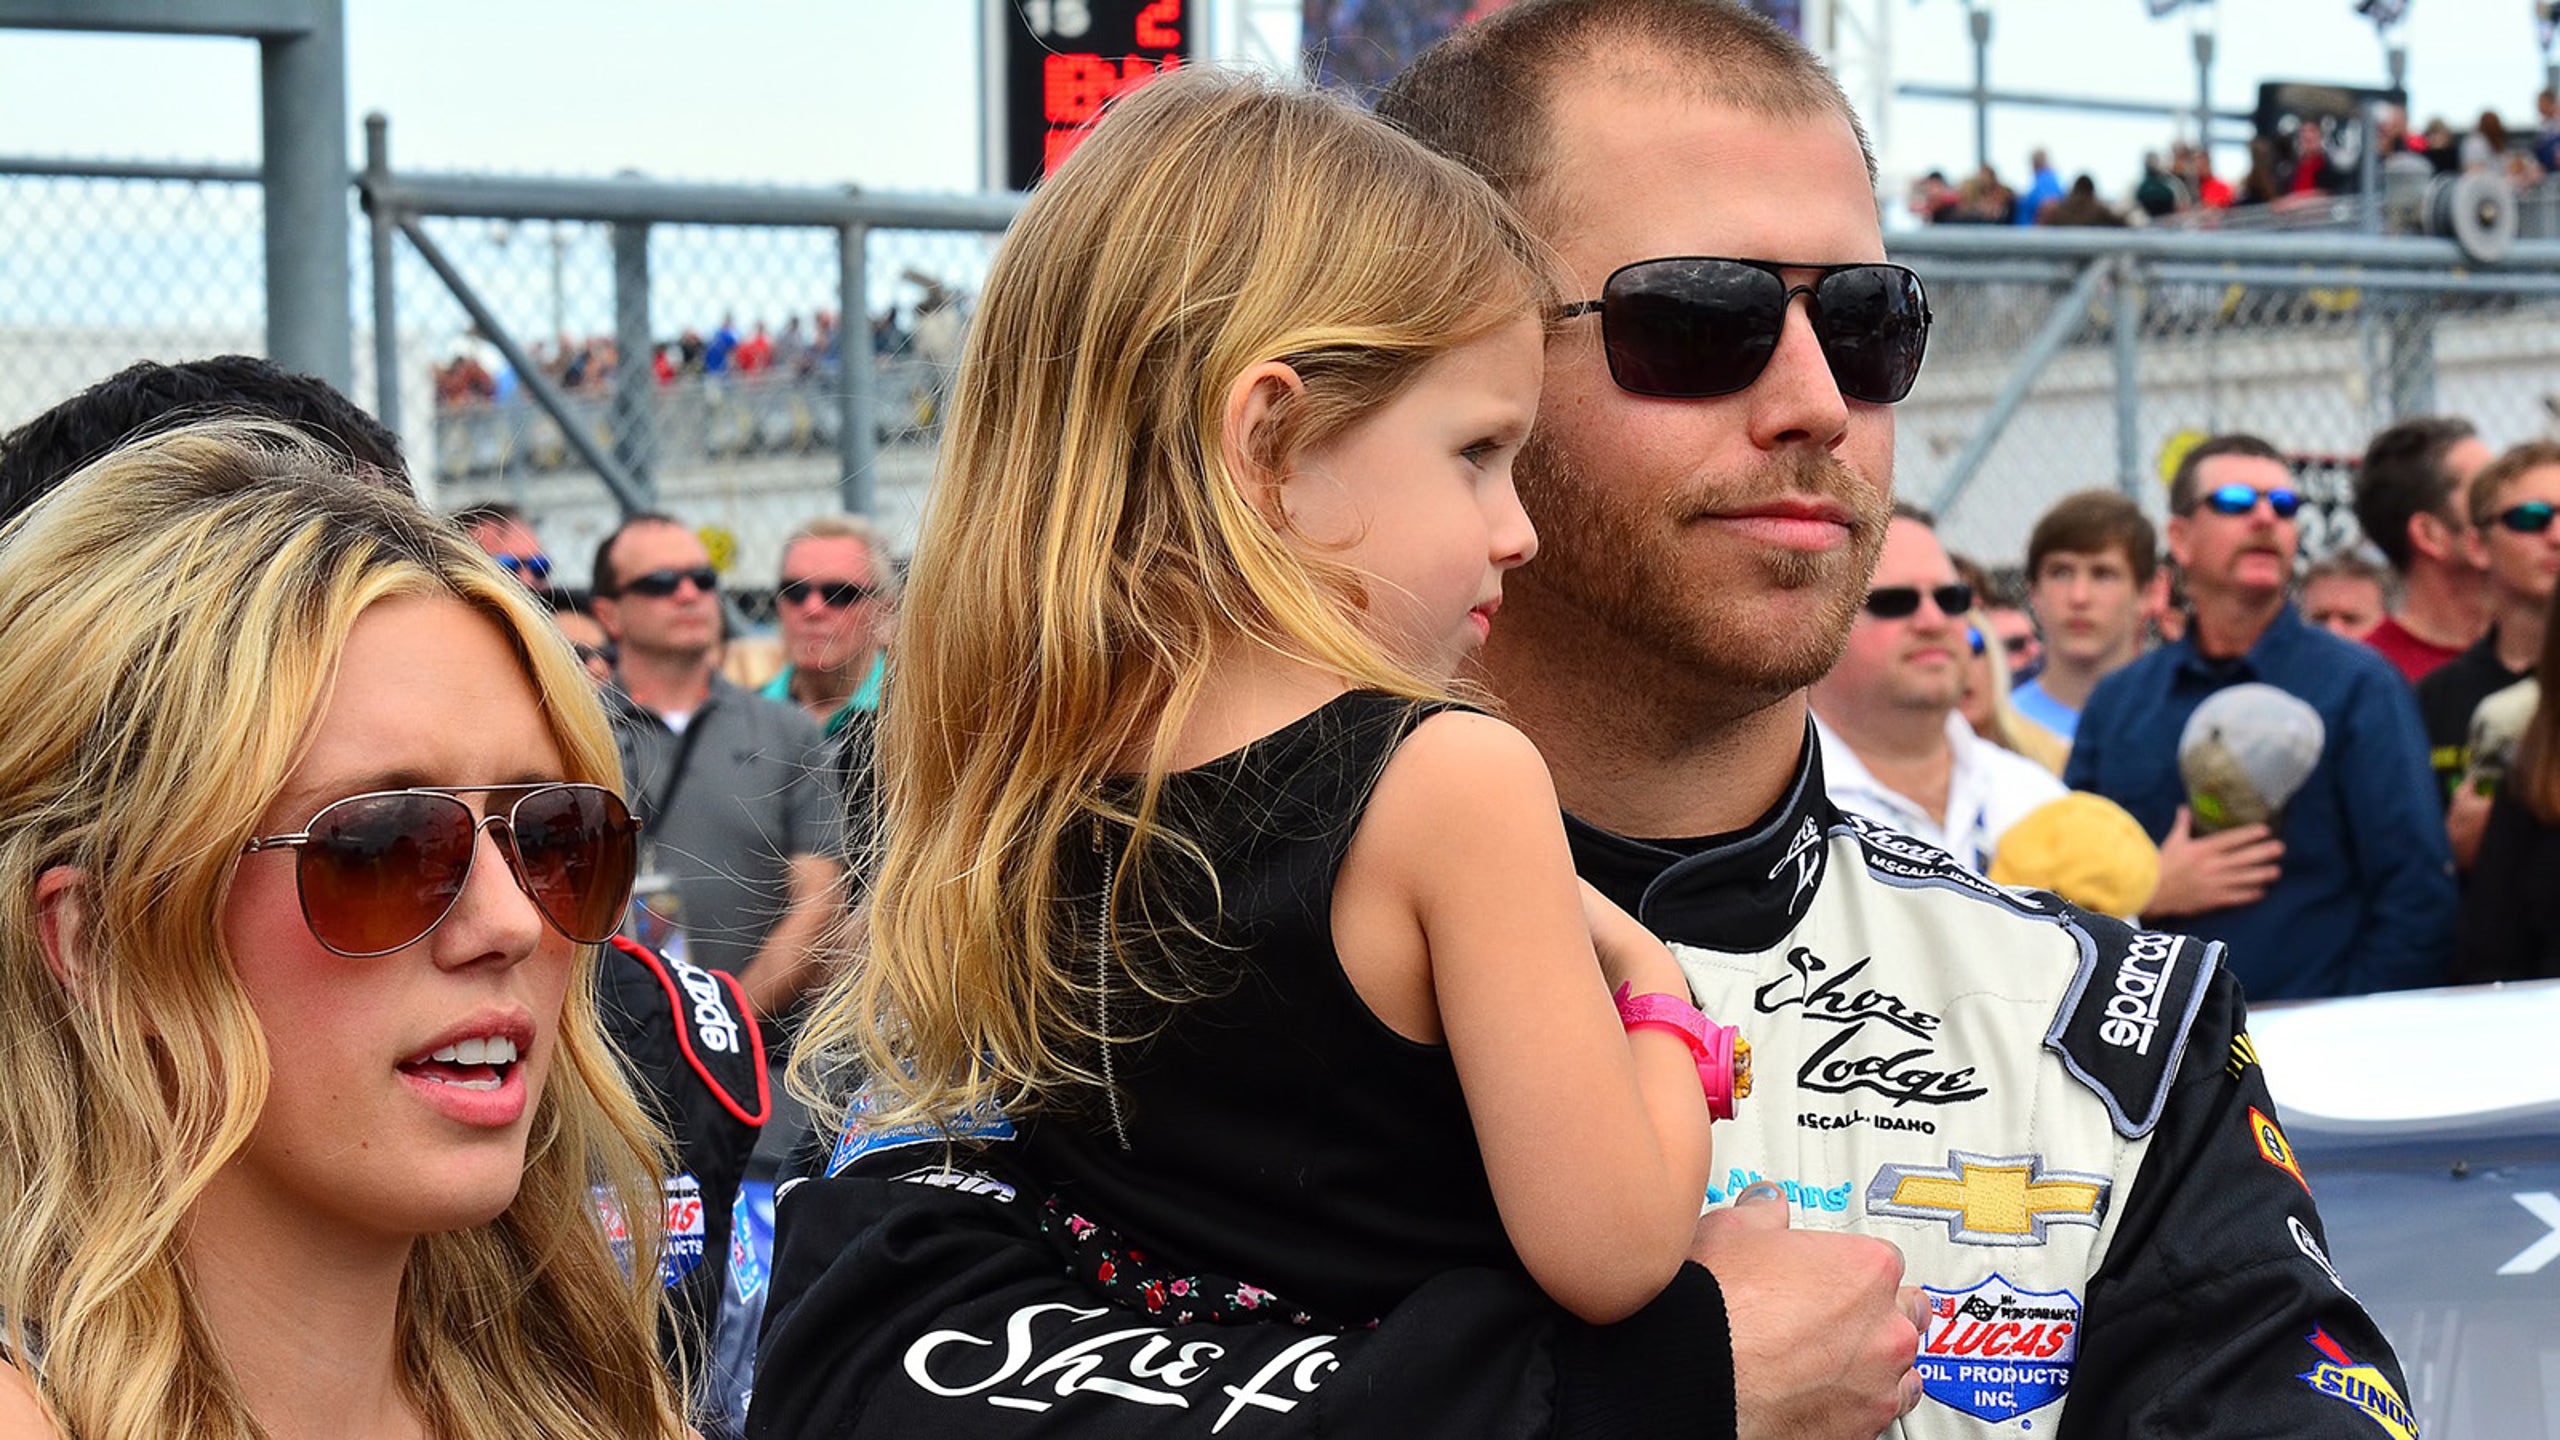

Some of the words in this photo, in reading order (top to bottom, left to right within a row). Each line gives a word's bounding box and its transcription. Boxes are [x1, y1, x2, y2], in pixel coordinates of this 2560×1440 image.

[1754, 946, 1941, 1042] Shore
[2099, 934, 2187, 1056] sparco
[1797, 1021, 1989, 1108] Lodge
[1874, 1114, 1936, 1136] IDAHO
[1917, 1363, 1952, 1381] OIL
[1959, 1365, 2070, 1386] PRODUCTS
[1925, 1320, 2073, 1358] LUCAS
[2320, 1368, 2420, 1440] SUNOC
